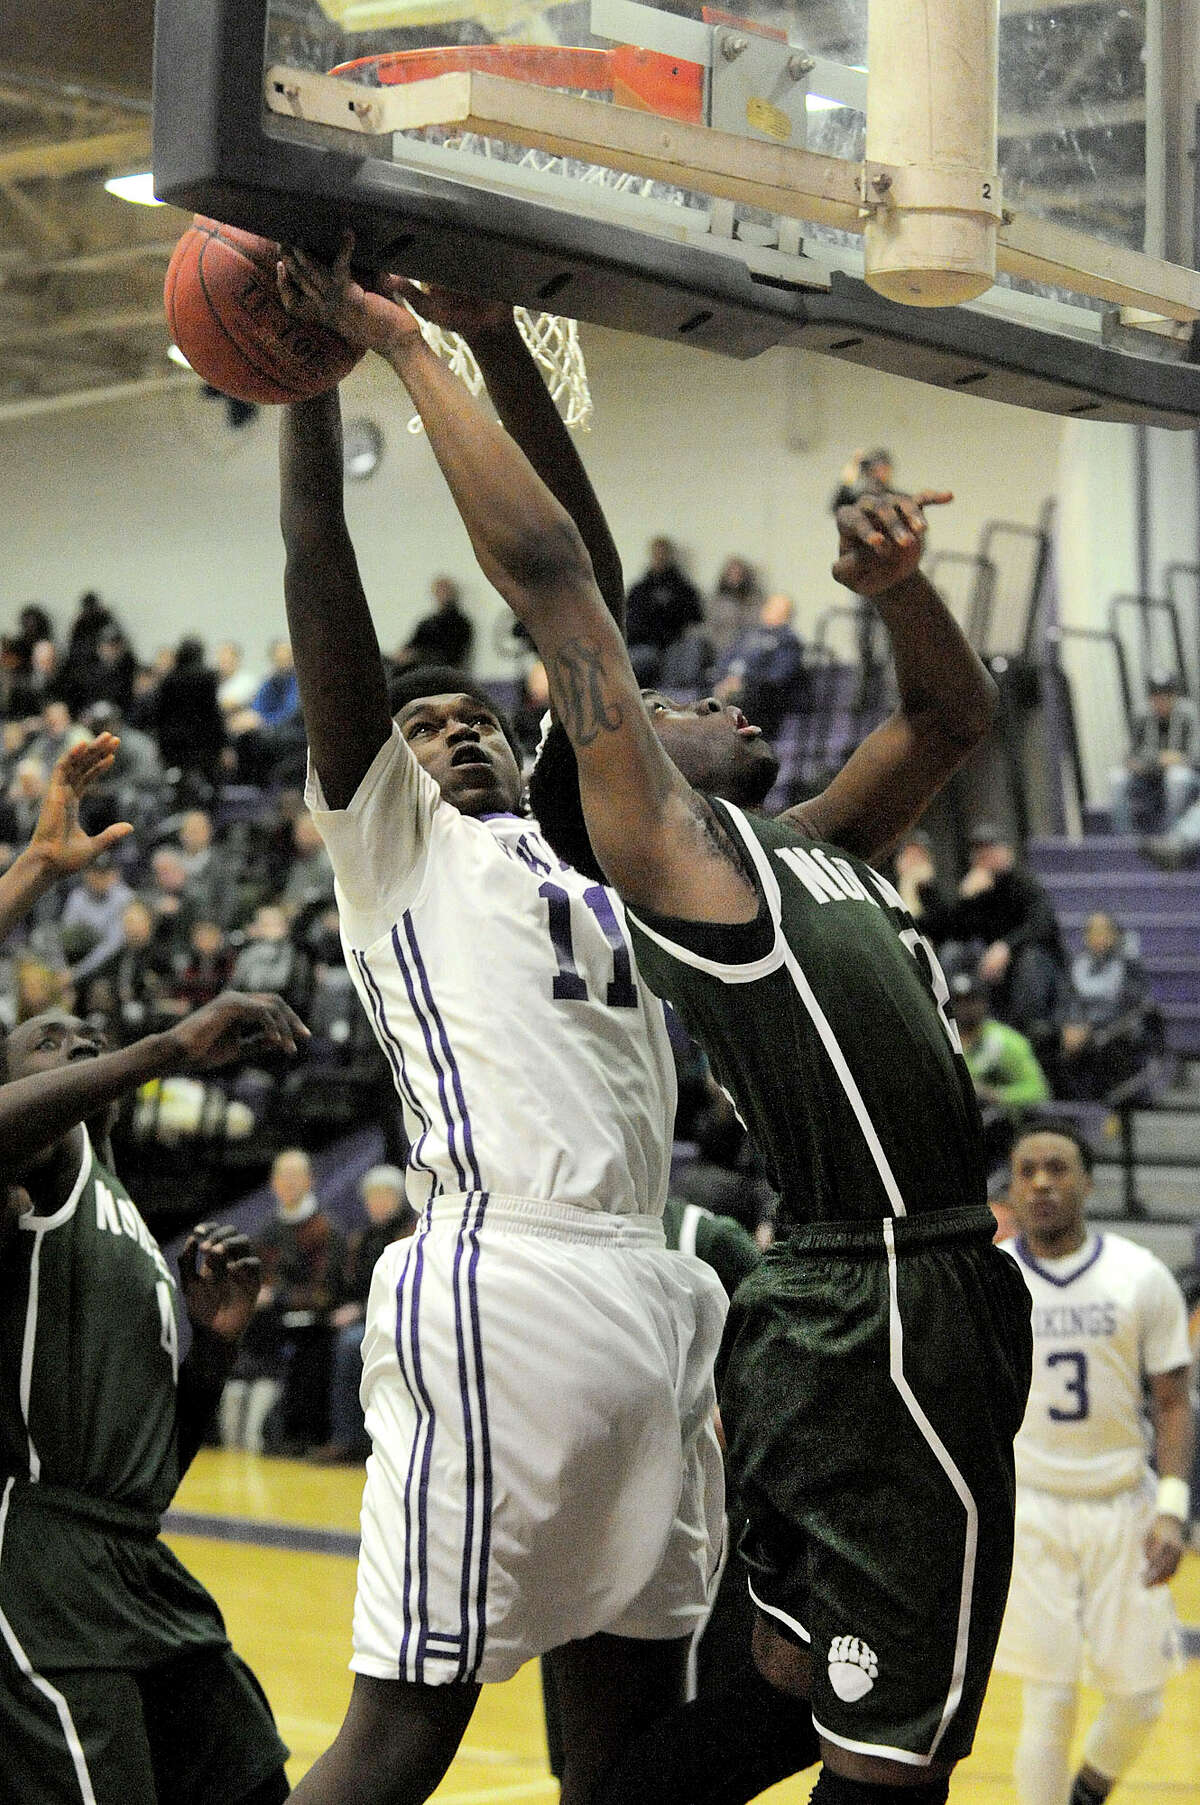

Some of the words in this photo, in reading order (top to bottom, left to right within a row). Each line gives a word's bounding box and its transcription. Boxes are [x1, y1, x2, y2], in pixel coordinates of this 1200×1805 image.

[982, 183, 992, 200] 2
[538, 881, 638, 1008] 11
[1048, 1351, 1089, 1421] 3
